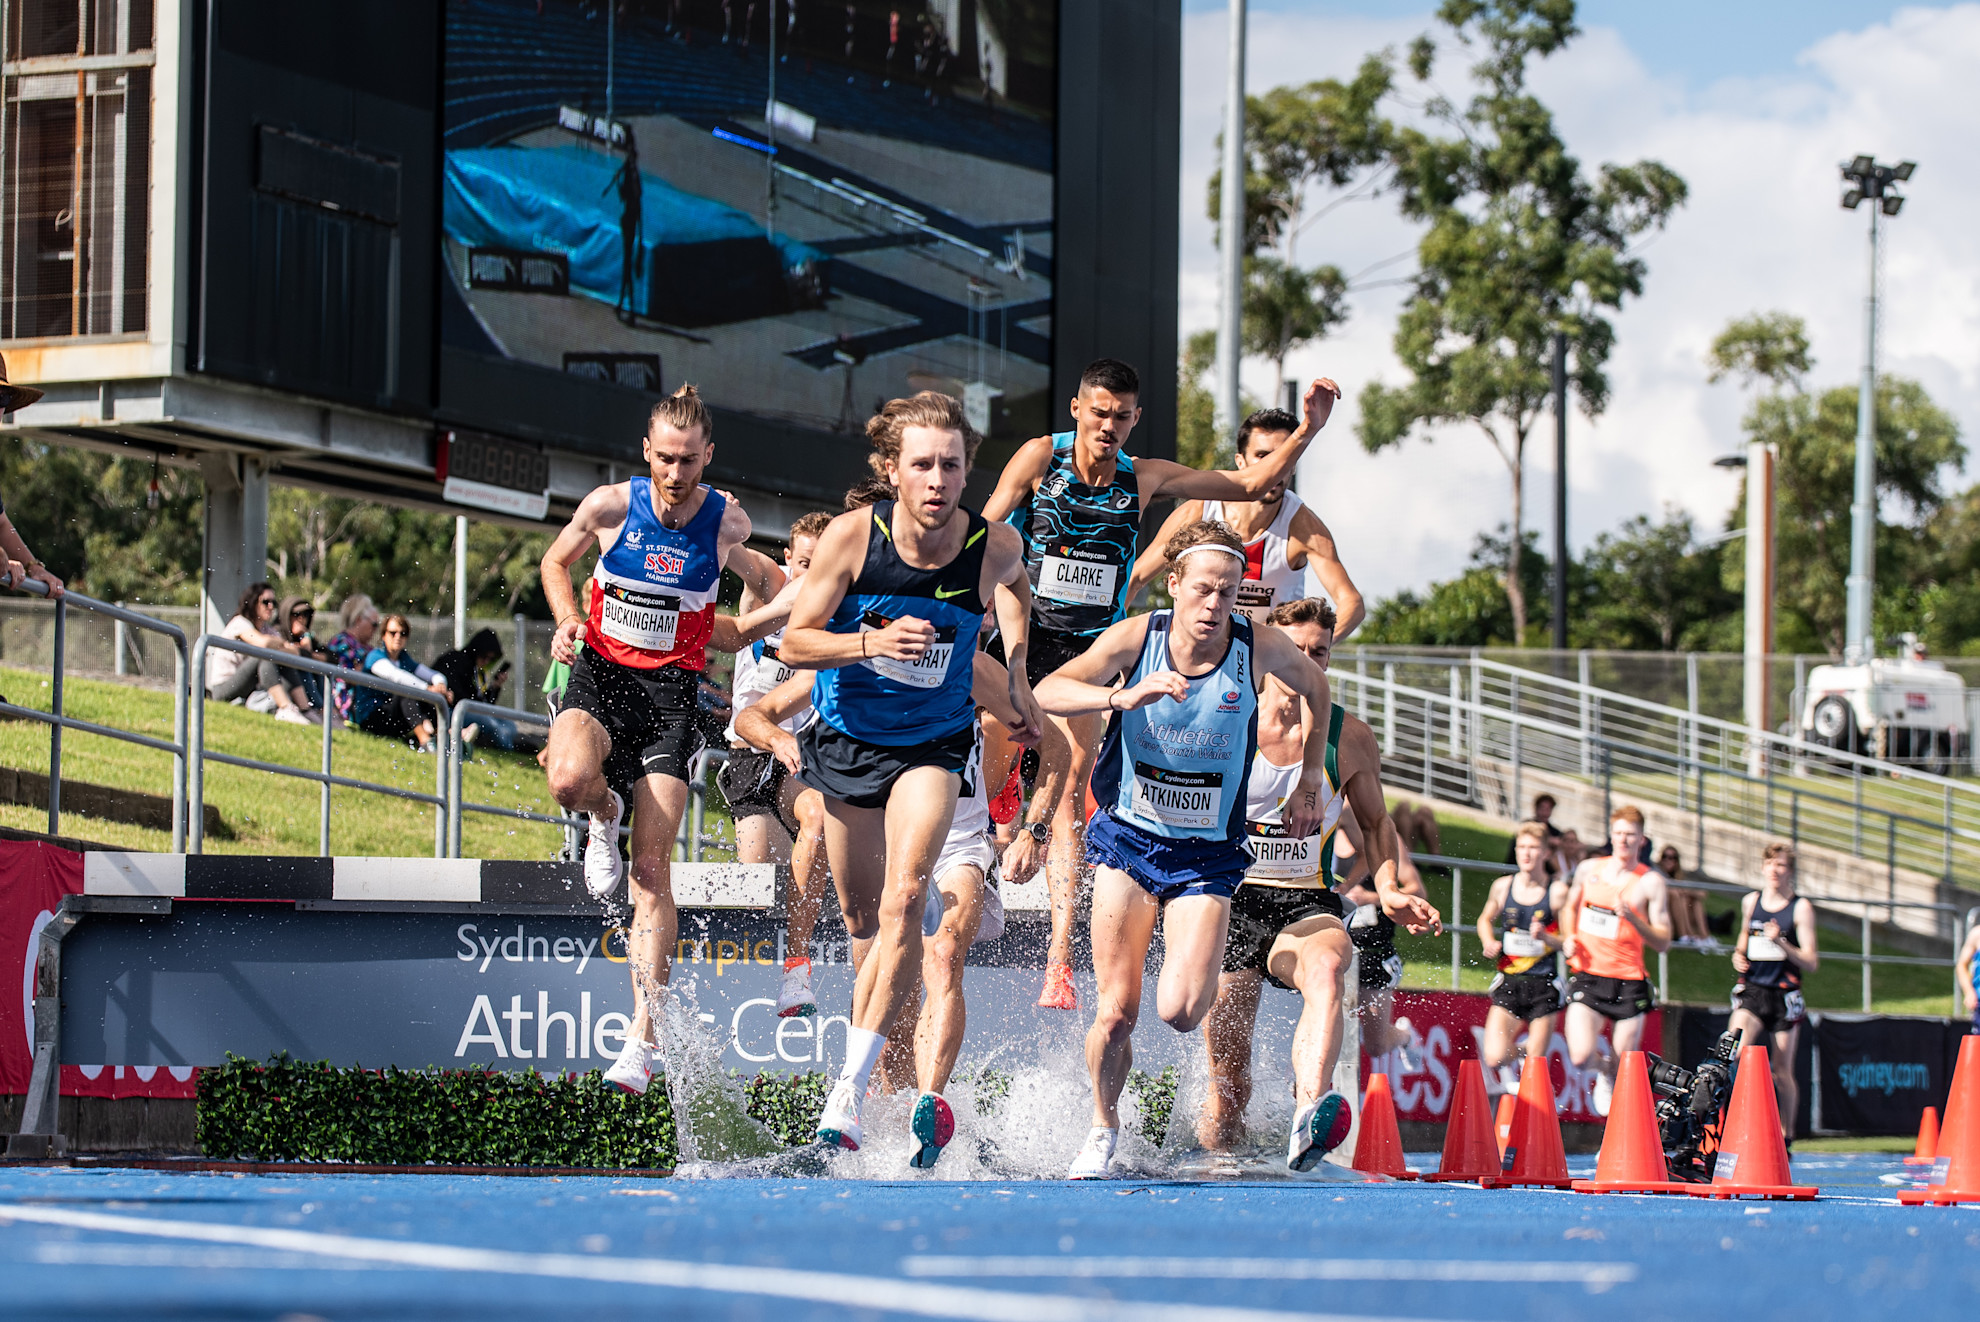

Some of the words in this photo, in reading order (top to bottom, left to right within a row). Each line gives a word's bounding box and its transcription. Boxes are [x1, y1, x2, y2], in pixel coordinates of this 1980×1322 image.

[645, 544, 656, 552] ST.
[656, 545, 690, 559] STEPHENS
[1072, 549, 1108, 561] sydney.com
[643, 552, 686, 576] SSH
[1056, 563, 1104, 587] CLARKE
[645, 571, 680, 584] HARRIERS
[627, 593, 667, 607] sydney.com
[605, 600, 676, 634] BUCKINGHAM
[1142, 719, 1231, 748] Athletics
[1133, 733, 1159, 753] New
[1160, 743, 1195, 759] South
[1198, 747, 1233, 761] Wales
[1164, 774, 1206, 785] sydney.com
[1140, 782, 1212, 811] ATKINSON
[1253, 841, 1309, 861] TRIPPAS
[1838, 1054, 1931, 1098] sydney.com
